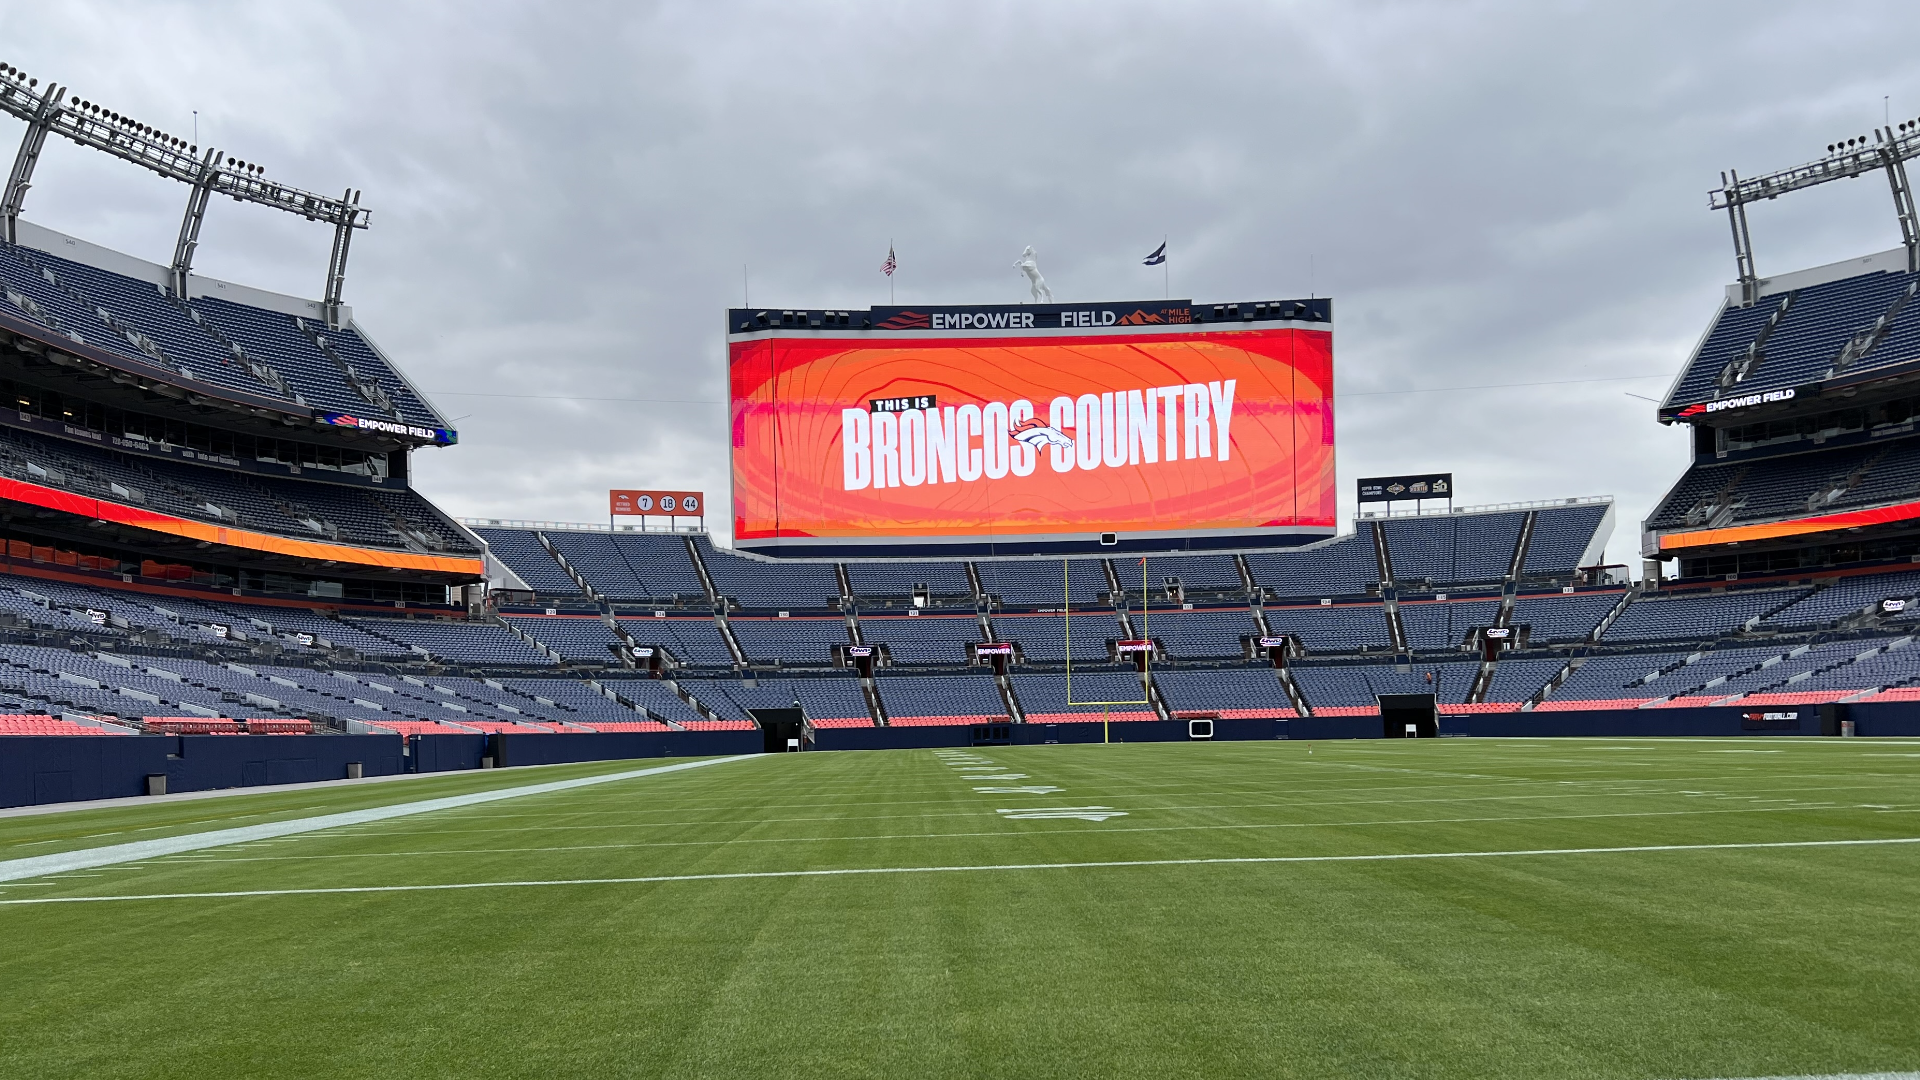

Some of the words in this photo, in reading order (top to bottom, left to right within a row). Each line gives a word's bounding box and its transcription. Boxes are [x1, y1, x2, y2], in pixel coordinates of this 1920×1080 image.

[1168, 308, 1190, 316] MILE
[932, 312, 1035, 329] EMPOWER
[1061, 310, 1117, 327] FIELD
[1168, 316, 1192, 324] HIGH
[875, 398, 909, 412] THIS
[914, 396, 929, 409] IS
[1706, 394, 1761, 412] EMPOWER
[1763, 389, 1796, 402] FIELD
[358, 418, 408, 435] EMPOWER
[408, 425, 435, 439] FIELD
[1049, 379, 1237, 473] COUNTRY
[841, 399, 1036, 491] BRONCOS
[1433, 482, 1448, 492] 50
[642, 498, 648, 508] 7
[663, 498, 673, 509] 18
[684, 499, 696, 509] 44
